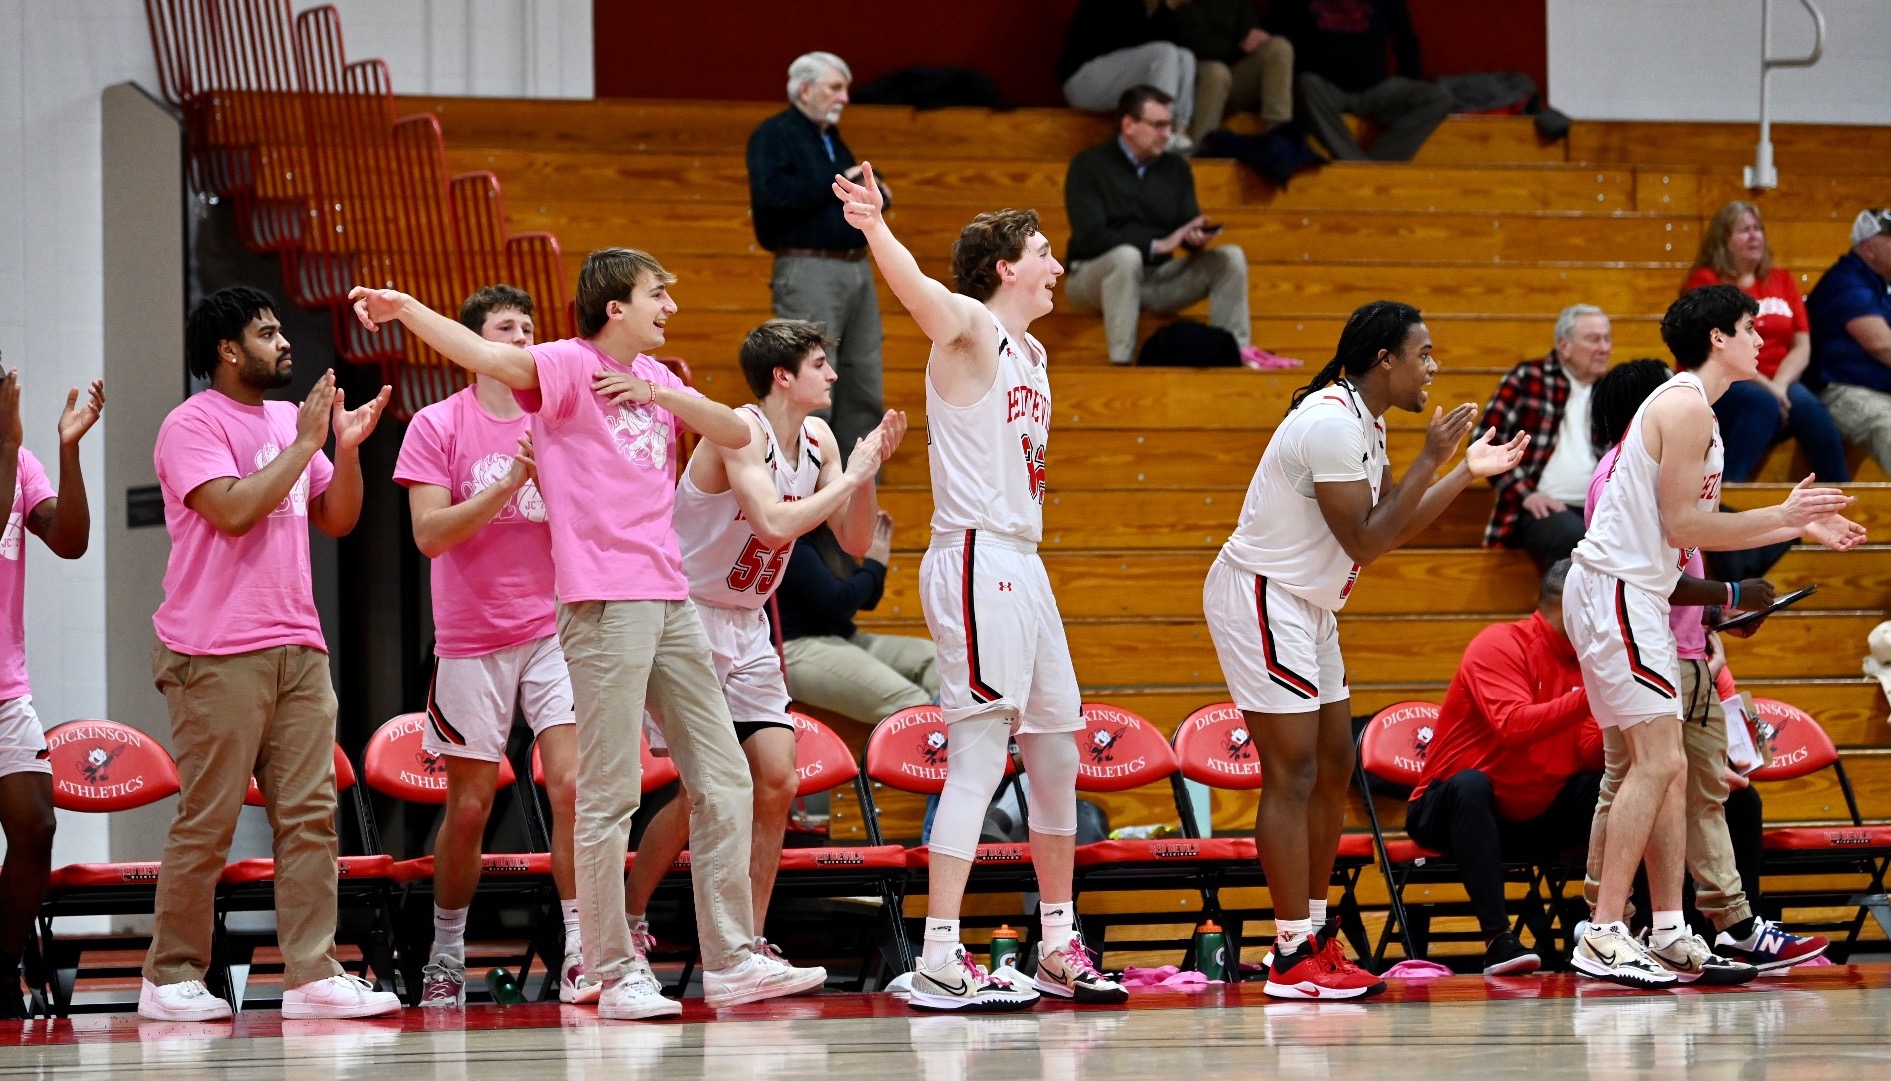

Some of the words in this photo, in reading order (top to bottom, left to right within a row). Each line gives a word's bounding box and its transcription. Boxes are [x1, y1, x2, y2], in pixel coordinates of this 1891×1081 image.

[525, 500, 536, 510] JC
[726, 533, 793, 595] 55
[890, 711, 944, 736] DICKIN
[1082, 710, 1141, 730] KINSON
[1195, 708, 1245, 732] DICKIN
[1381, 706, 1440, 730] DICKINS
[1754, 703, 1801, 722] INSON
[49, 726, 141, 751] DICKINSON
[1079, 756, 1146, 778] THLETICS
[1206, 756, 1261, 775] ATHLET
[1768, 745, 1808, 769] ETICS
[400, 770, 448, 790] ATHLE
[901, 762, 948, 780] ATHLE
[58, 775, 144, 799] ATHLETICS
[1758, 933, 1785, 955] N
